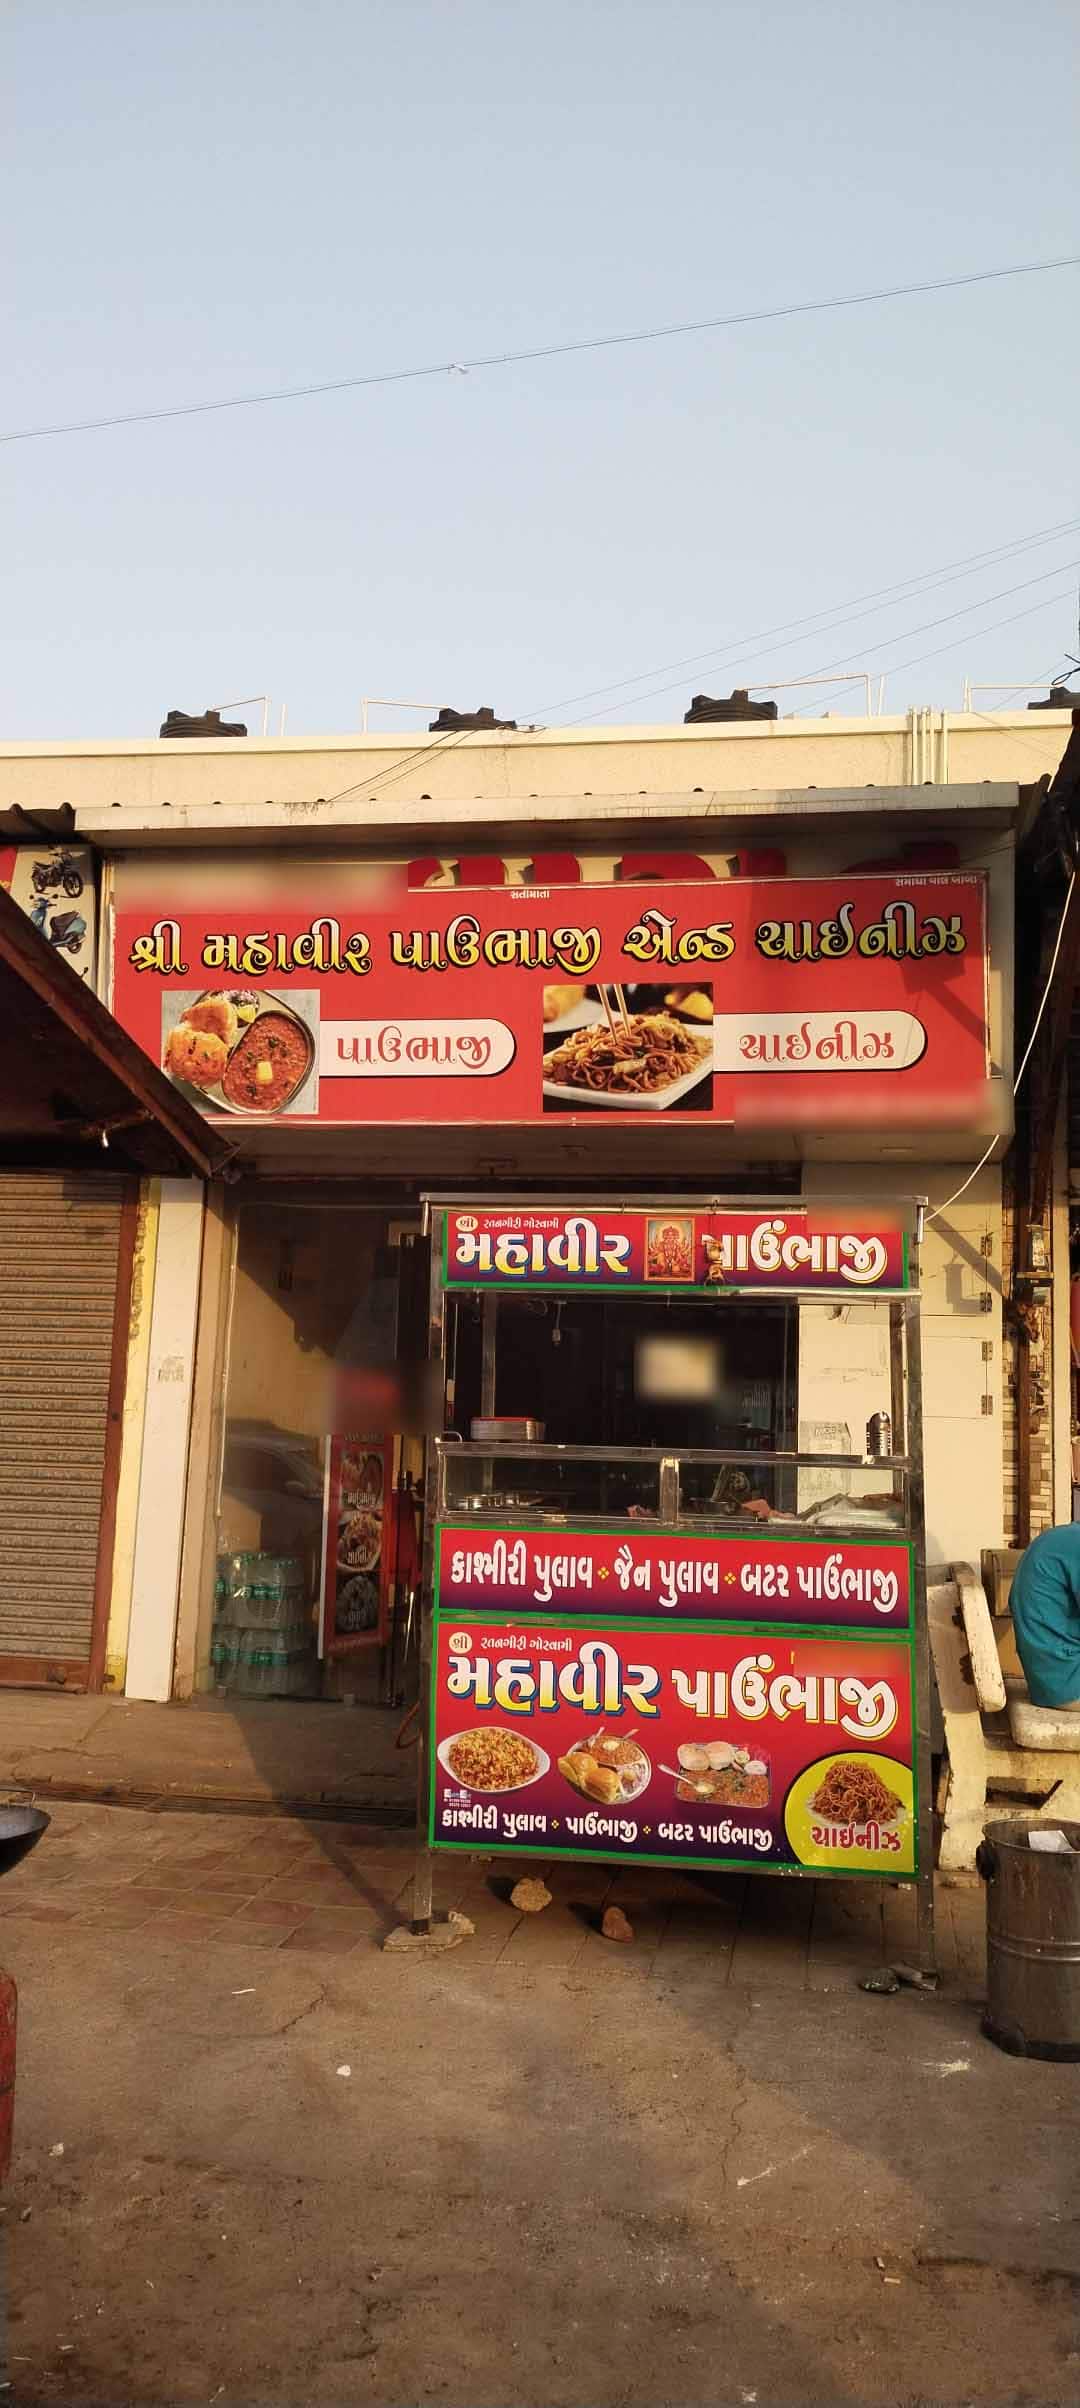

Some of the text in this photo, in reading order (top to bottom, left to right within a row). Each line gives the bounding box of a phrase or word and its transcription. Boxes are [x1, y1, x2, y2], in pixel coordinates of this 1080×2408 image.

[129, 901, 967, 976] શ્રી મહાવીર પાઉભાજી એન્ડ ચાઈનીઝ
[335, 1025, 492, 1070] પાઉભાજી
[738, 1020, 895, 1063] ચાઈનીઝ
[454, 1217, 888, 1284] મહાવીર પાઉંભાજી
[450, 1538, 593, 1602] કાશ્મીરી પુલાવ
[613, 1543, 719, 1608] જૈન પુલાવ
[740, 1552, 899, 1614] બટર પાઉંભાજી
[447, 1641, 899, 1742] મહાવીર પાઉંભાજી
[441, 1804, 547, 1838] કાશ્મીરી પુલાવ
[565, 1811, 638, 1843] પાઉંભાજી
[657, 1819, 774, 1852] બટર પાઉંભાજી
